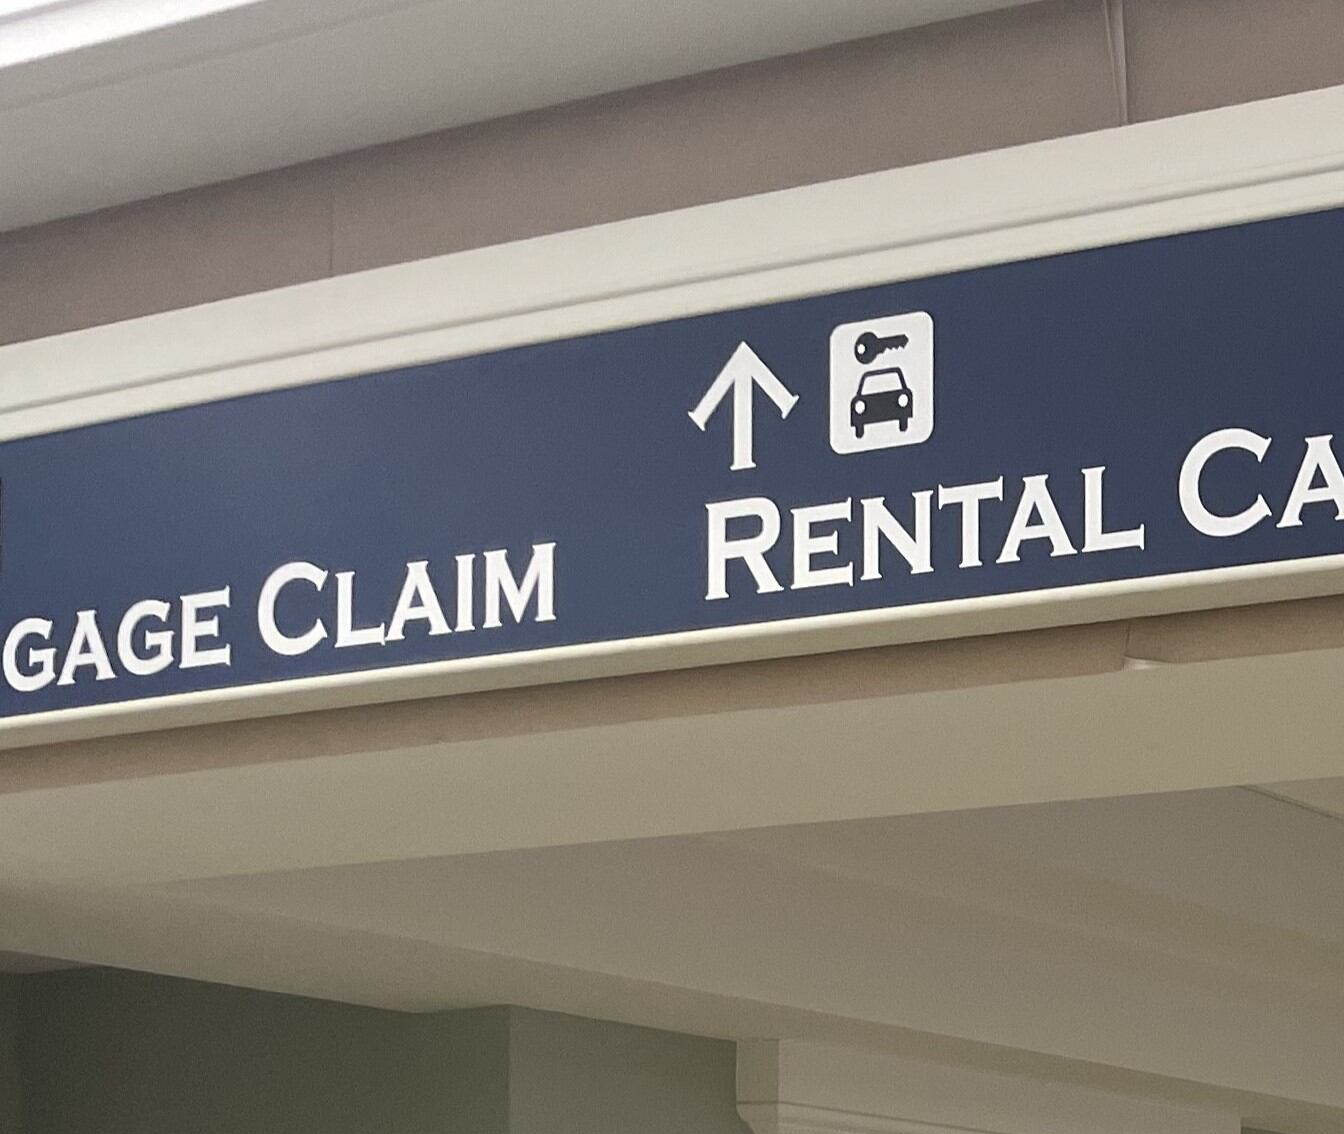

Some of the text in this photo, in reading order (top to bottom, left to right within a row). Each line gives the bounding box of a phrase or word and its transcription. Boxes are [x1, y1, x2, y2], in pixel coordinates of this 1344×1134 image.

[704, 464, 1146, 601] RENTAL
[2, 541, 558, 693] GAGE CLAIM
